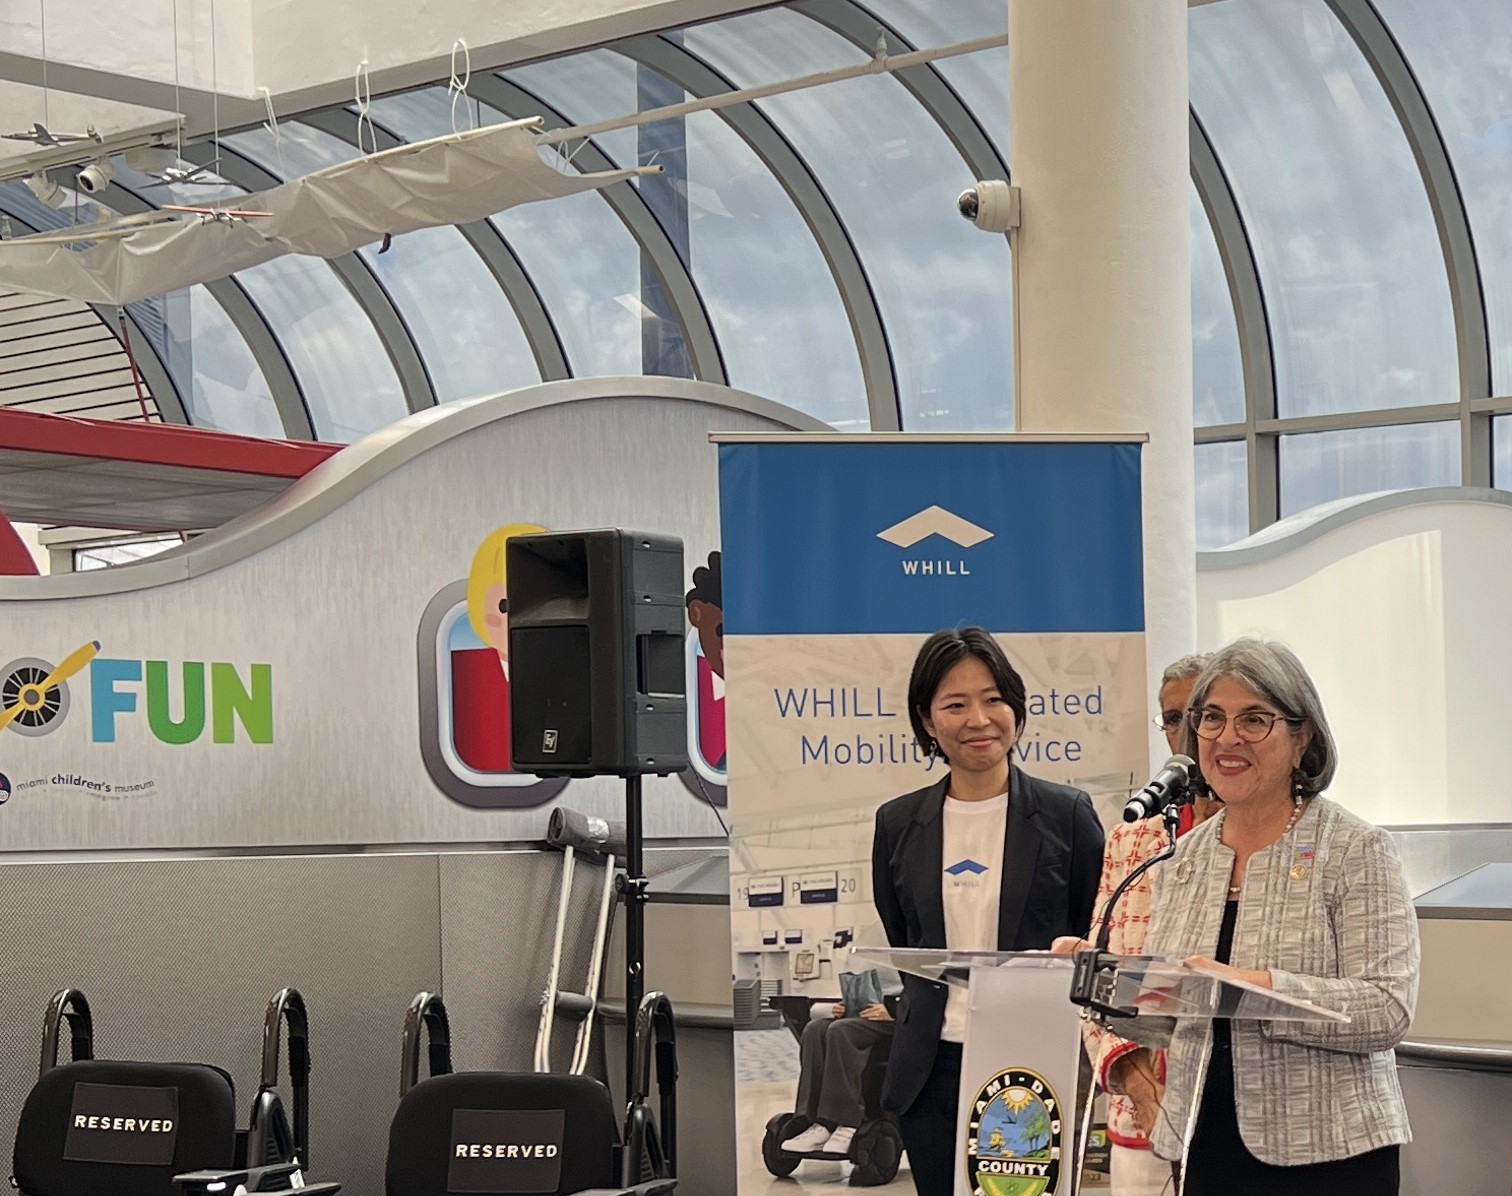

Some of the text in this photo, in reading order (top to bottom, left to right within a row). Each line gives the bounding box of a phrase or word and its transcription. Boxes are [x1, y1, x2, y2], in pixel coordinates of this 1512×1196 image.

[901, 560, 971, 576] WHILL
[90, 659, 274, 745] FUN
[774, 685, 1103, 718] WHILL ated
[1016, 732, 1082, 762] vice
[16, 773, 155, 793] miami children's museum
[74, 1114, 173, 1133] RESERVED
[968, 1074, 1061, 1160] MIAMI-DADE
[455, 1144, 558, 1158] RESERVED
[978, 1160, 1049, 1176] COUNTY
